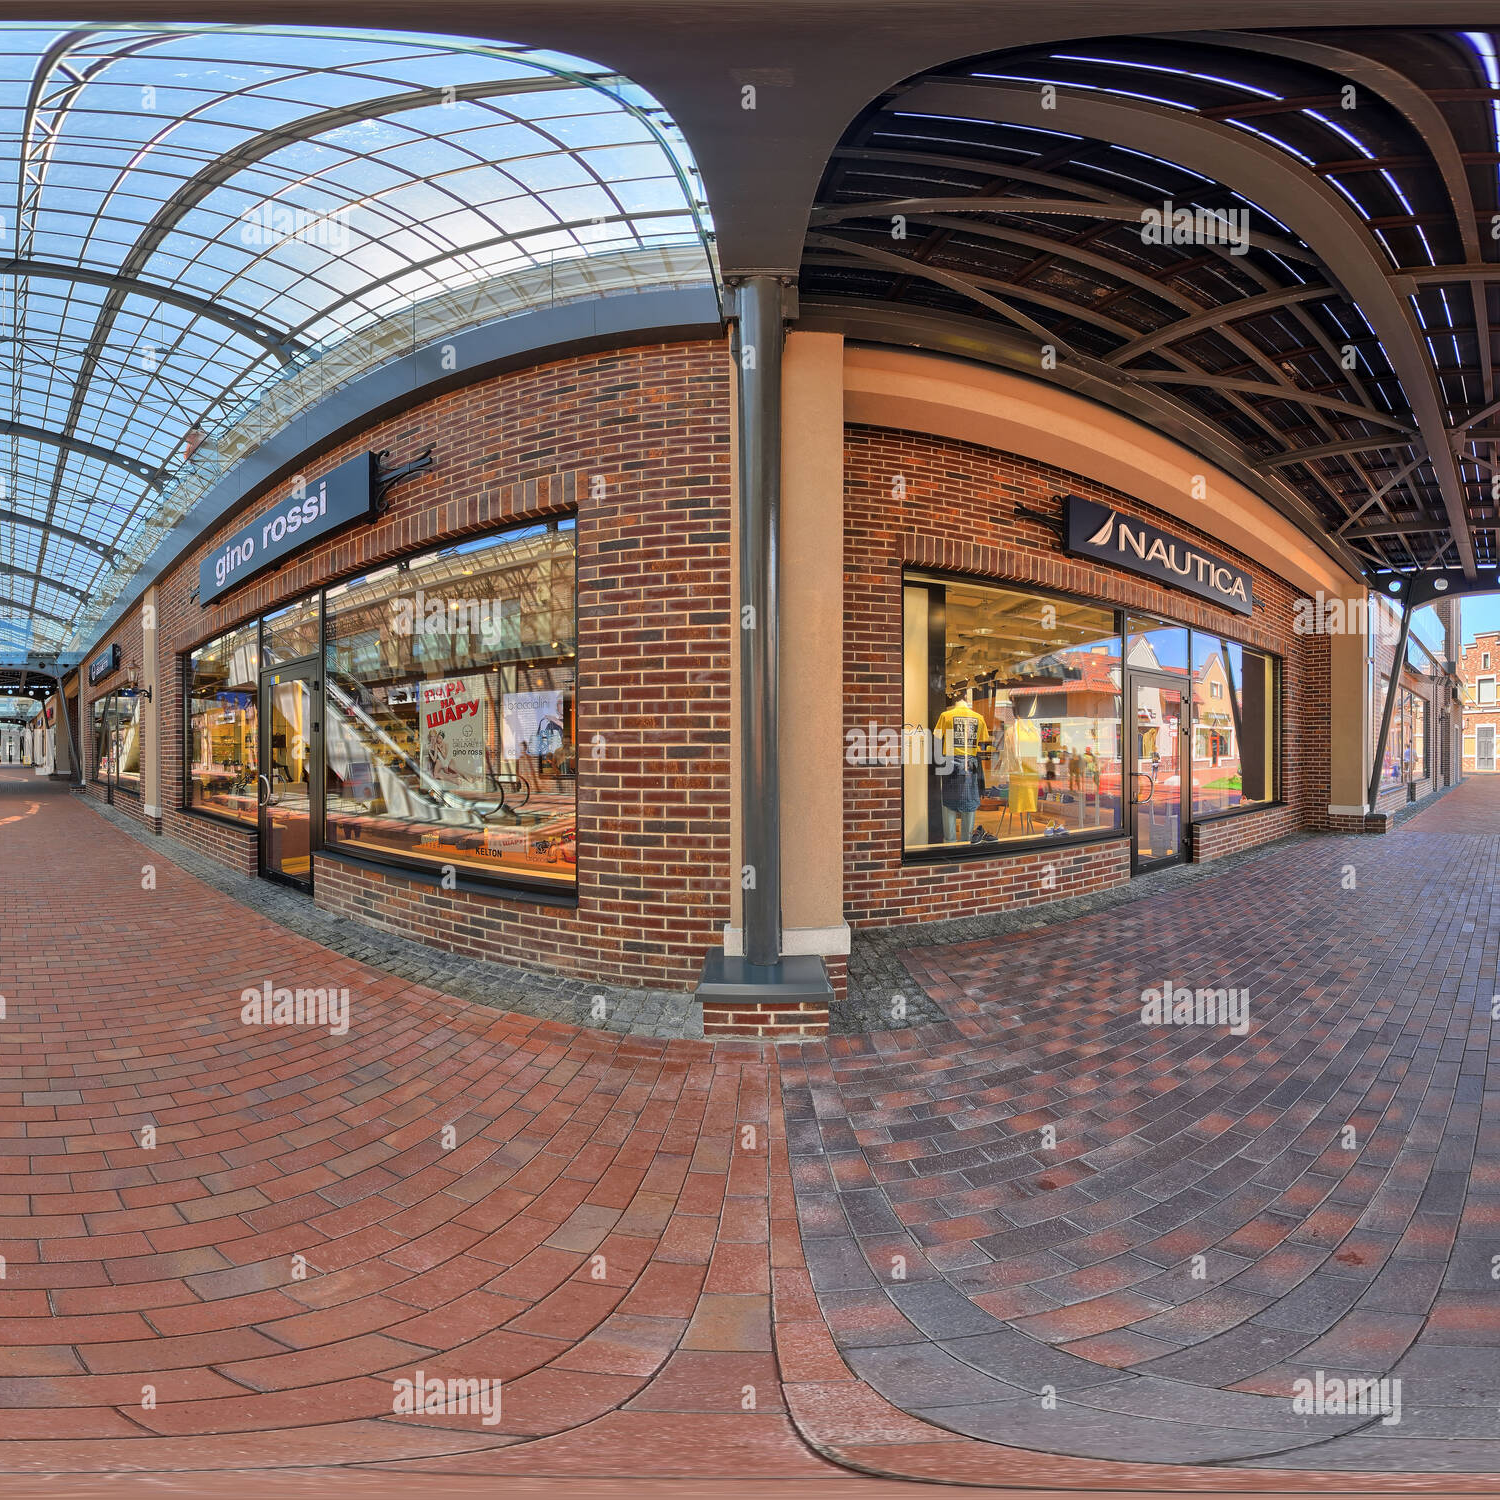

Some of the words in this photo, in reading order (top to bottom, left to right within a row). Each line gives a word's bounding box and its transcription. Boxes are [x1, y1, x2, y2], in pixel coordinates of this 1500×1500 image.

[216, 537, 254, 587] gino
[263, 481, 327, 549] rossi
[1119, 523, 1247, 602] NAUTICA
[424, 680, 466, 704] ПАРА
[440, 697, 455, 709] НА
[426, 699, 479, 728] ШАРУ
[475, 847, 502, 858] KELTON
